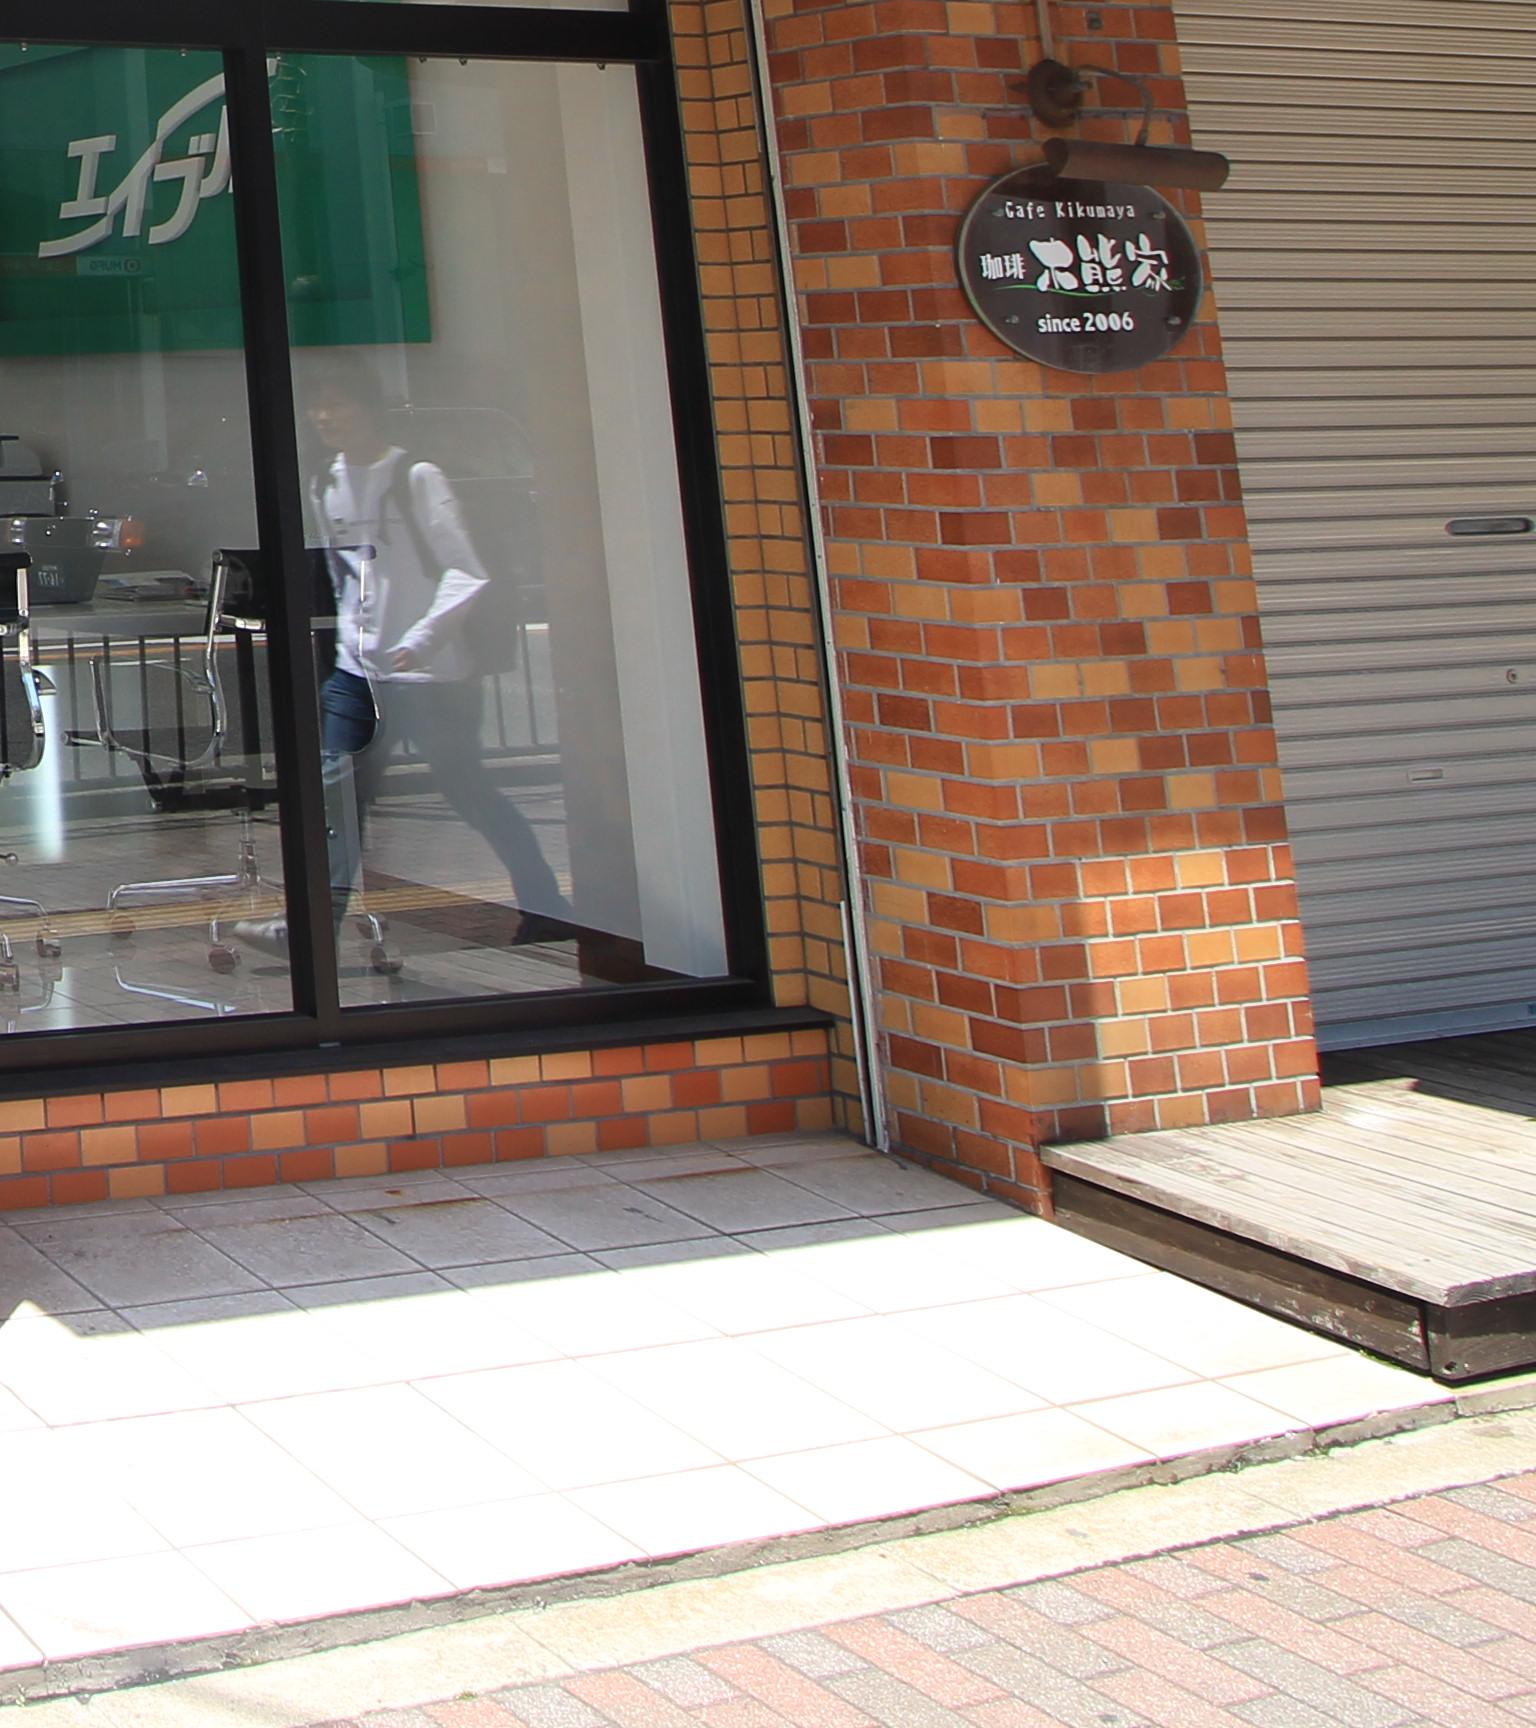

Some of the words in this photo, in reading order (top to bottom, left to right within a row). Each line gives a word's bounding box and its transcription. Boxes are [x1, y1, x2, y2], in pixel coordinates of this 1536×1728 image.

[38, 59, 268, 259] エイブ
[1004, 201, 1046, 219] Cafe
[1055, 201, 1136, 220] Kikumaya
[980, 252, 1026, 280] 珈琲
[1037, 313, 1081, 333] since
[1082, 311, 1135, 332] 2006
